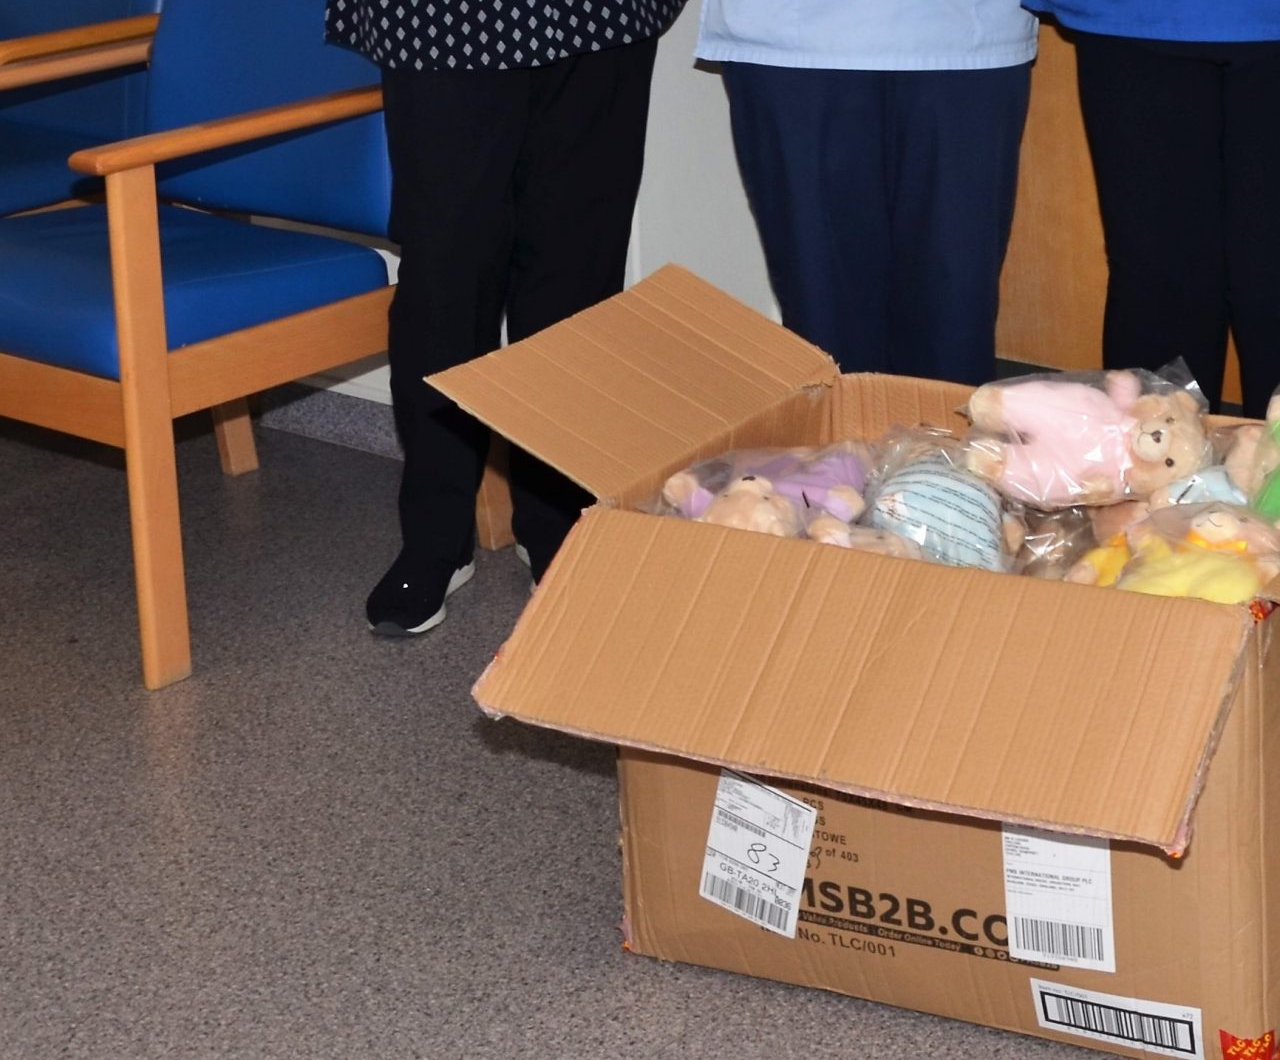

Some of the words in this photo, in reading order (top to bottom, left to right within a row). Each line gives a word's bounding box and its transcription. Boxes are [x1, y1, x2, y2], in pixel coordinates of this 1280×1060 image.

[812, 830, 847, 845] TOWE
[747, 843, 780, 872] 83
[826, 849, 836, 857] of
[840, 851, 859, 862] 403
[803, 912, 828, 926] Value
[830, 917, 868, 934] Products
[877, 928, 903, 941] Order
[904, 933, 934, 946] Online
[935, 939, 961, 953] Today
[798, 927, 825, 944] No.
[828, 933, 896, 957] TLC/001
[1227, 1039, 1246, 1056] TLC
[1244, 1039, 1261, 1057] TLC
